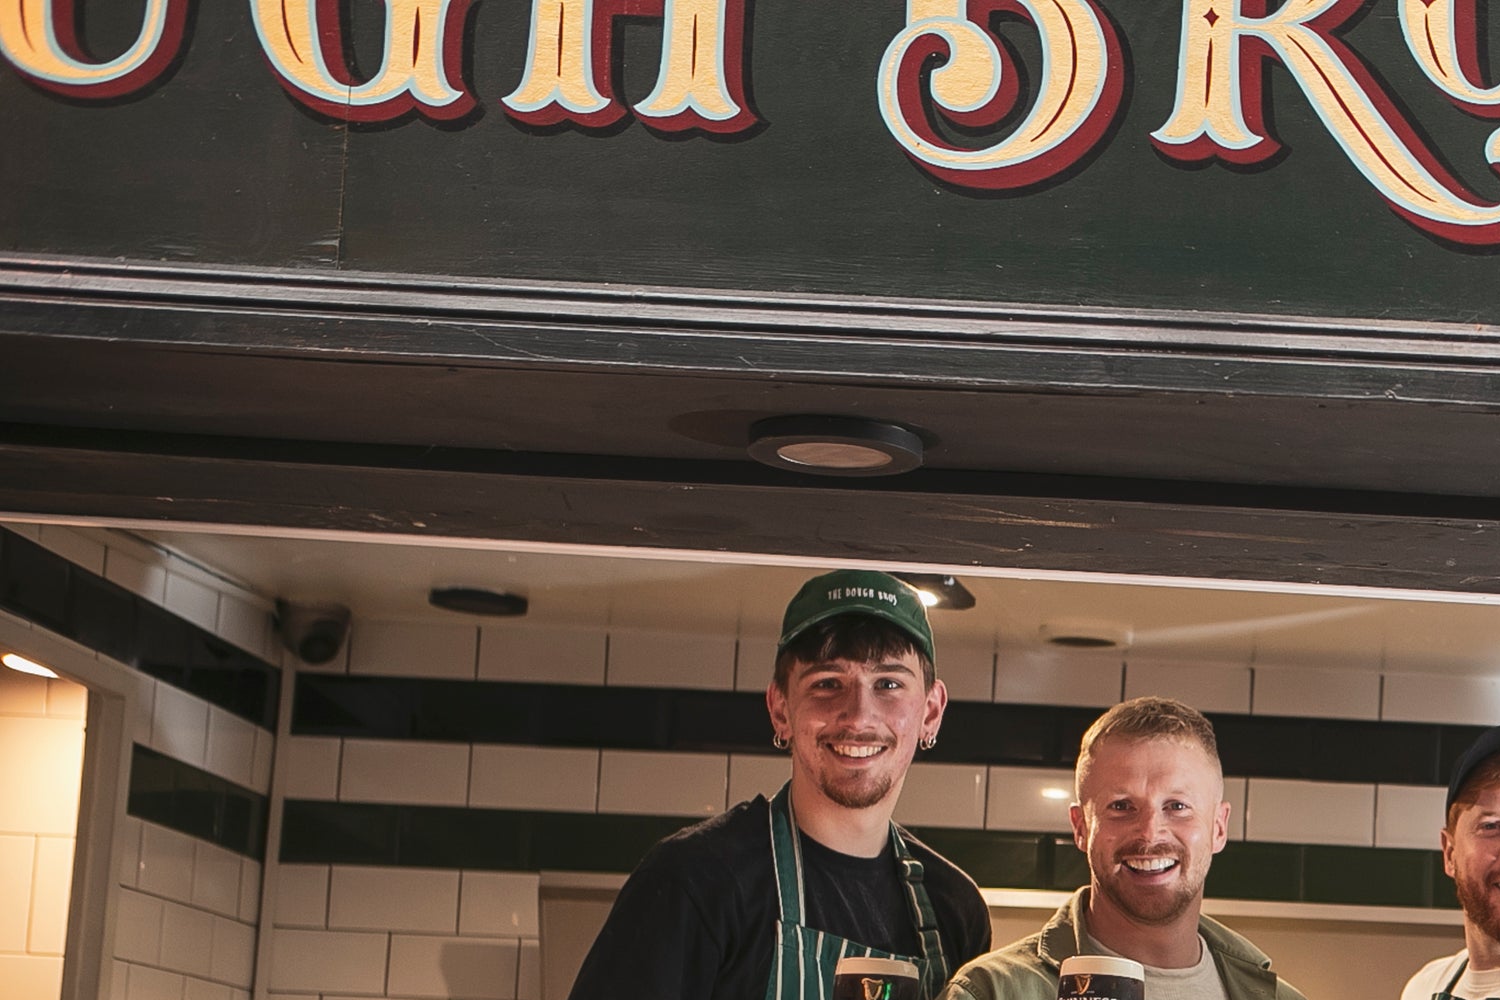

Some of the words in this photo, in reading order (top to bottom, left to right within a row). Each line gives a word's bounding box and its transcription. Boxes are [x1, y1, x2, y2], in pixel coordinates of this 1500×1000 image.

[828, 587, 842, 600] THE
[845, 586, 875, 599] DOUGH
[877, 590, 898, 606] BROS
